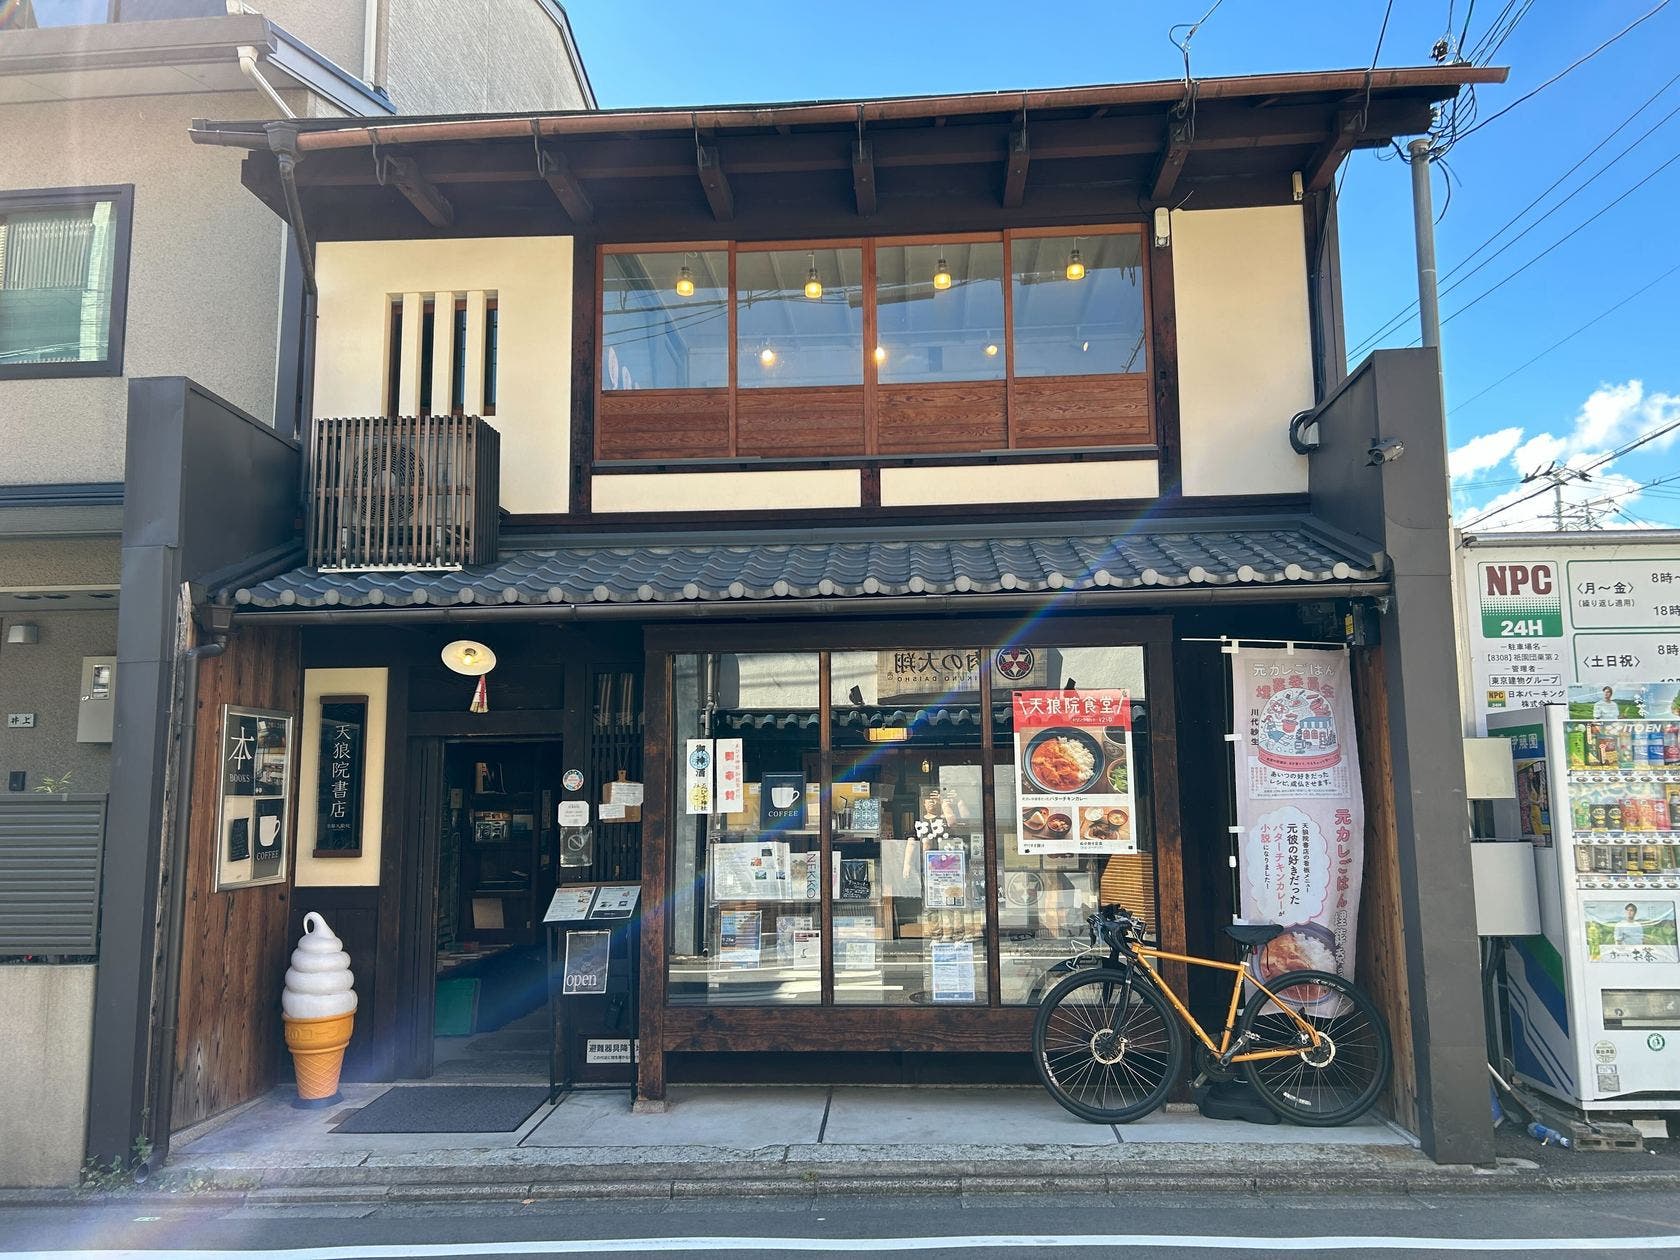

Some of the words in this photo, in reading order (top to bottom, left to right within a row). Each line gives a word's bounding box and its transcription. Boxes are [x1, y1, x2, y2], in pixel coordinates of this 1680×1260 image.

[1486, 565, 1552, 596] NPC
[1500, 620, 1543, 636] 24H
[1253, 663, 1335, 676] 元カレごはん
[1491, 676, 1558, 684] 東京建物グループ
[1488, 691, 1504, 699] NPC
[1508, 690, 1565, 698] 日本パーキング
[1029, 696, 1114, 715] 天狼院食堂
[10, 715, 32, 726] 井上
[228, 726, 255, 770] 本
[229, 773, 250, 783] BOOKS
[330, 724, 352, 818] 天狼院書店
[1270, 771, 1329, 780] あいつの好きだった
[768, 810, 799, 818] COFFEE
[256, 850, 279, 861] COFFEE
[1335, 808, 1352, 909] 元カレごはん
[1273, 823, 1286, 917] バターチキンカレーが
[1286, 823, 1300, 905] 元彼の好きだった
[806, 853, 816, 899] NEKKO
[566, 973, 597, 991] open
